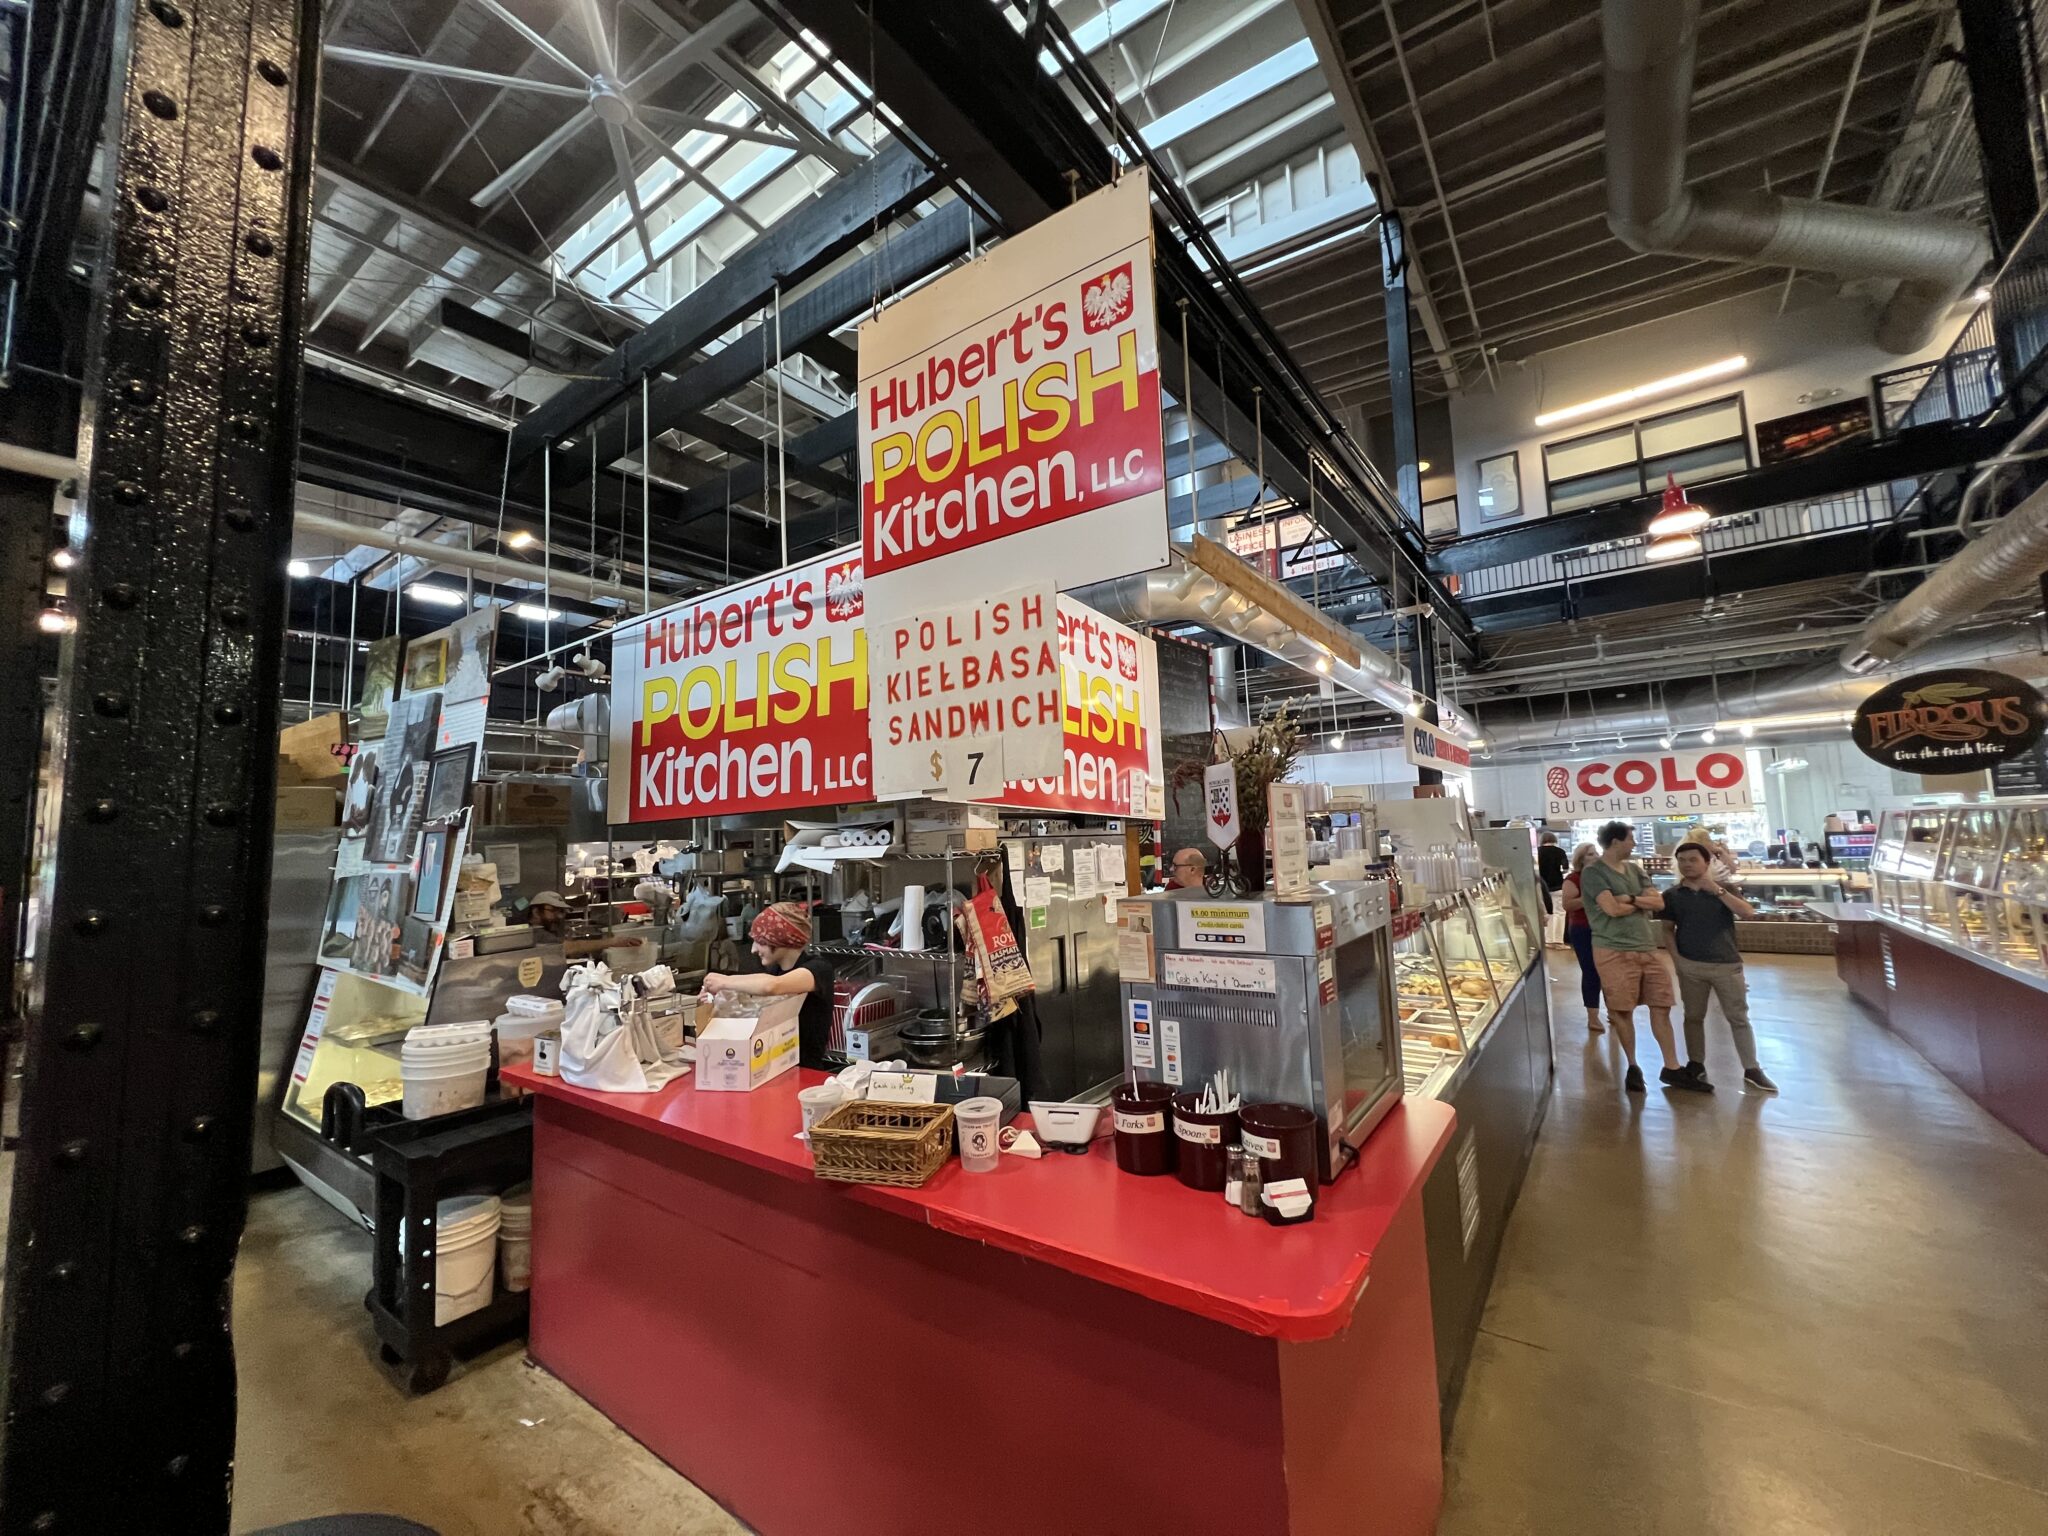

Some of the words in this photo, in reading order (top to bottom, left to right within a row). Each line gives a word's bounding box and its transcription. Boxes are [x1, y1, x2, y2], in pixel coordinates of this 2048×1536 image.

[870, 301, 1069, 431] Hubert's
[871, 329, 1140, 504] POLISH
[873, 450, 1084, 562] Kitchen,
[1091, 448, 1145, 493] LLC
[1229, 527, 1271, 543] USINESS
[1301, 562, 1325, 573] HEE!
[644, 578, 813, 669] Hubert's
[895, 594, 1043, 660] POLISH
[1056, 608, 1113, 670] ert's
[641, 628, 868, 747] POLISH
[886, 641, 1057, 704] KIEŁBASA
[888, 689, 1060, 746] SANDWICH
[1060, 664, 1142, 750] LISH
[1867, 696, 2030, 749] FIRDOUS
[639, 738, 819, 808] Kitchen,
[824, 753, 867, 790] LLC
[930, 749, 944, 782] $
[966, 752, 984, 786] 7
[1577, 753, 1744, 797] COLO
[1894, 750, 1918, 761] Live
[1920, 746, 1939, 759] the
[1943, 743, 1973, 757] fresh
[1550, 796, 1654, 814] BUTCHER
[1665, 794, 1678, 809] &
[1689, 790, 1747, 807] DELI
[1210, 909, 1249, 919] minimum
[992, 932, 1016, 948] ROY
[1175, 971, 1190, 984] Cash
[873, 1081, 888, 1089] Cash
[899, 1083, 914, 1094] King
[1121, 1119, 1144, 1129] Forks
[1178, 1125, 1207, 1139] Spoons
